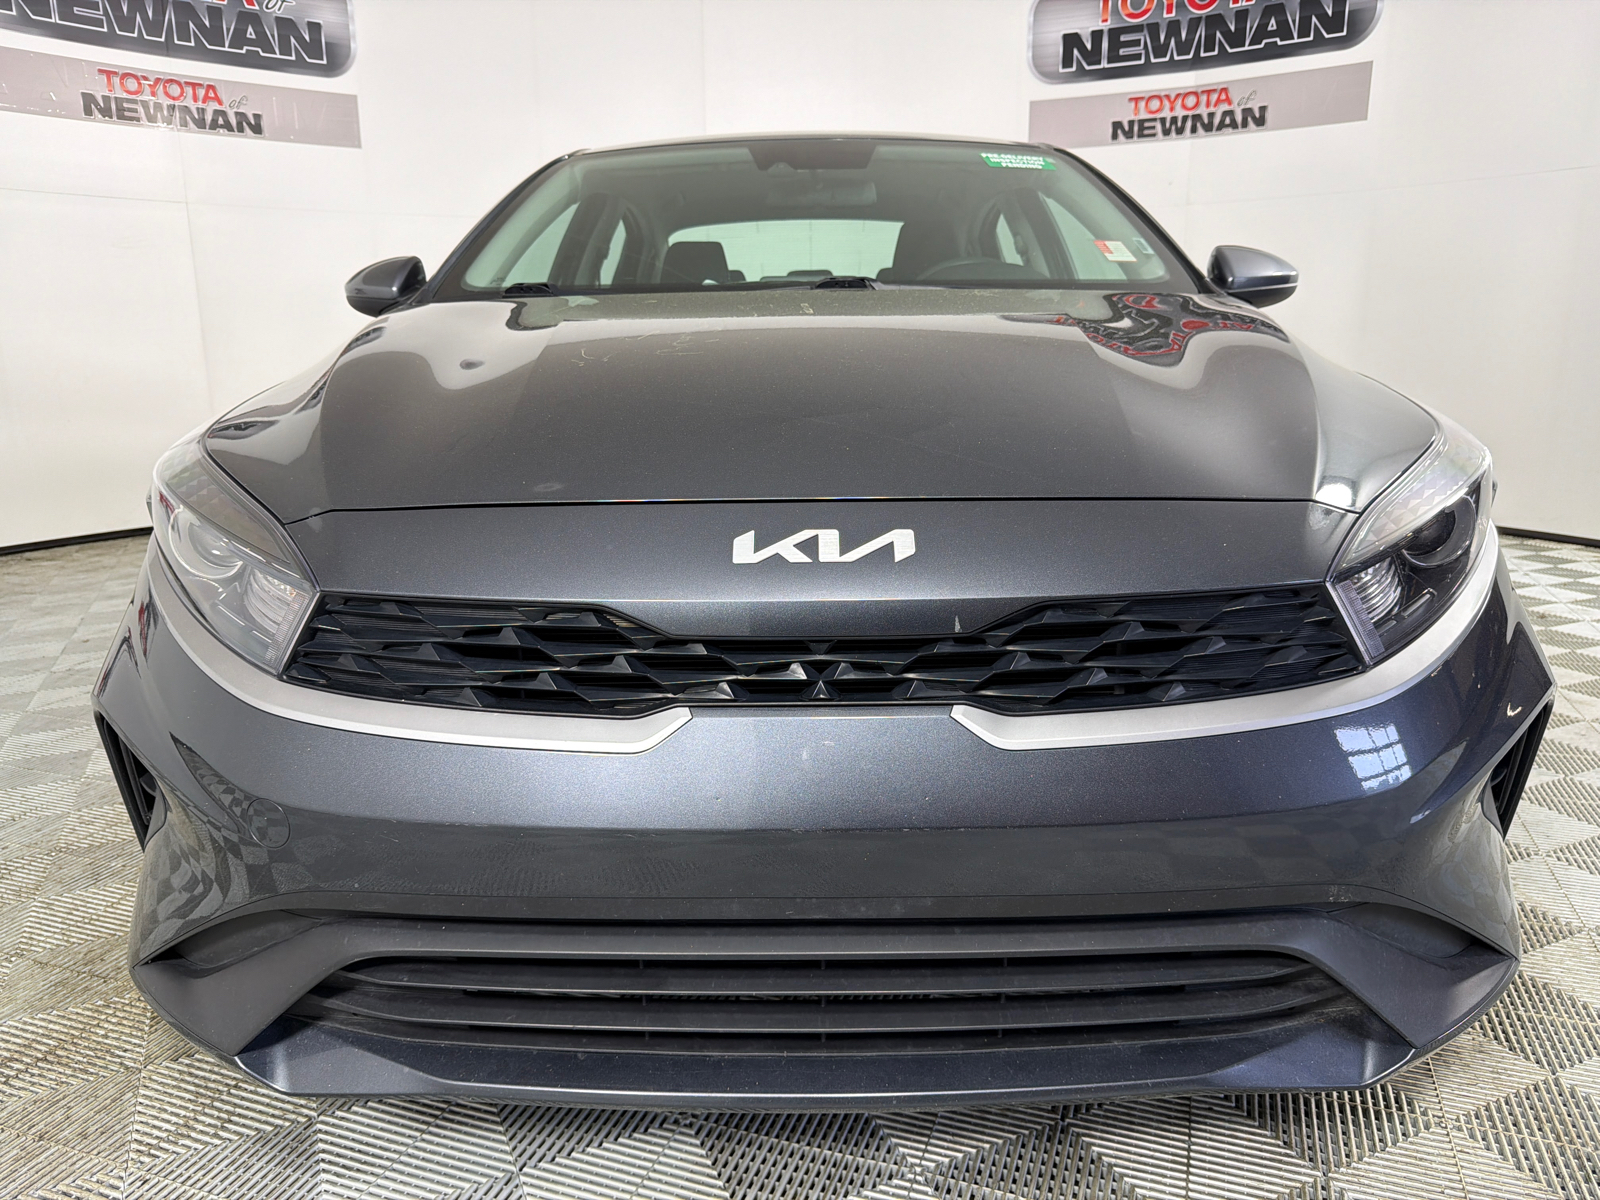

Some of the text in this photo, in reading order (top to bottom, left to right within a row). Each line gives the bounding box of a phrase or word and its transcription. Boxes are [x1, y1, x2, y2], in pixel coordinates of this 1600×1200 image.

[1059, 0, 1347, 72] NEWNAN
[97, 68, 248, 110] TOYOTA of
[1128, 86, 1257, 117] TOYOTA of
[80, 91, 264, 136] NEWNAN
[1110, 105, 1269, 142] NEWNAN
[732, 529, 916, 564] KIA
